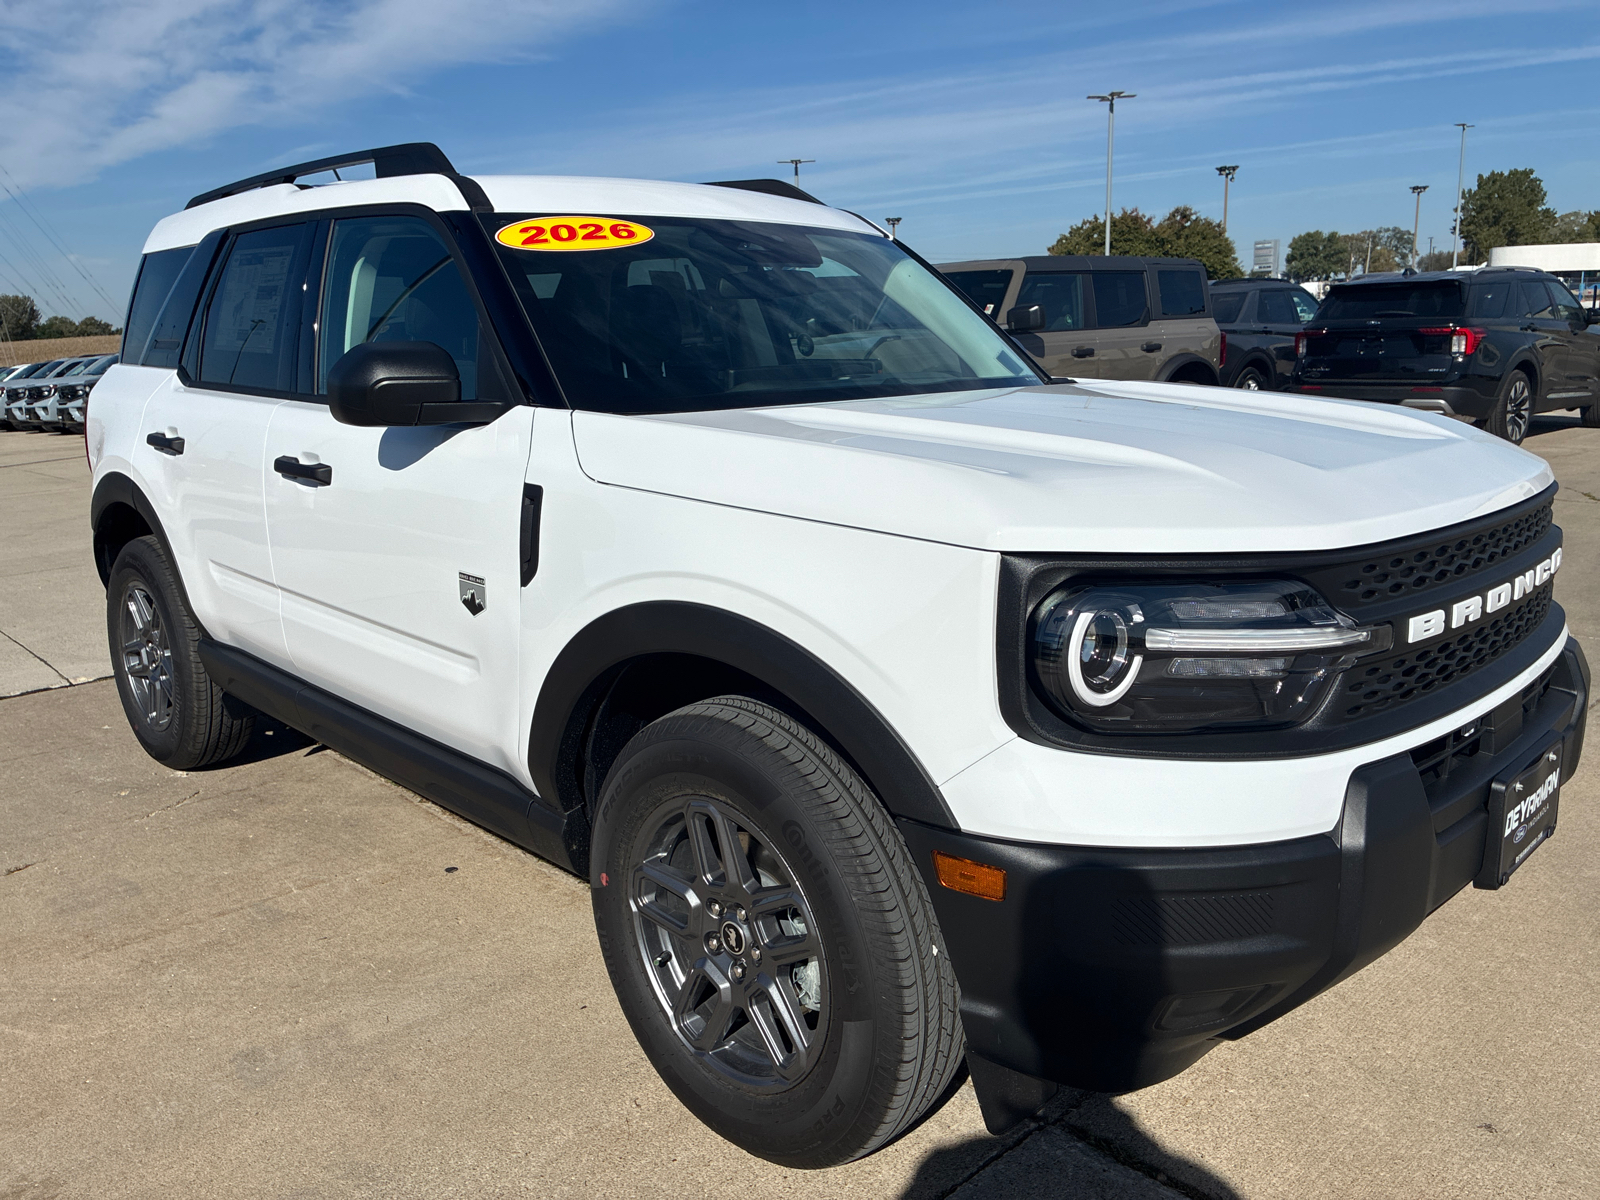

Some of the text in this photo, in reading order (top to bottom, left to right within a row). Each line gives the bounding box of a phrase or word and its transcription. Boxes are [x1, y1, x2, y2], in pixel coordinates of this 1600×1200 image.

[519, 223, 637, 245] 2026
[1408, 548, 1562, 643] BRONCO
[1504, 767, 1560, 838] DEYARMAN
